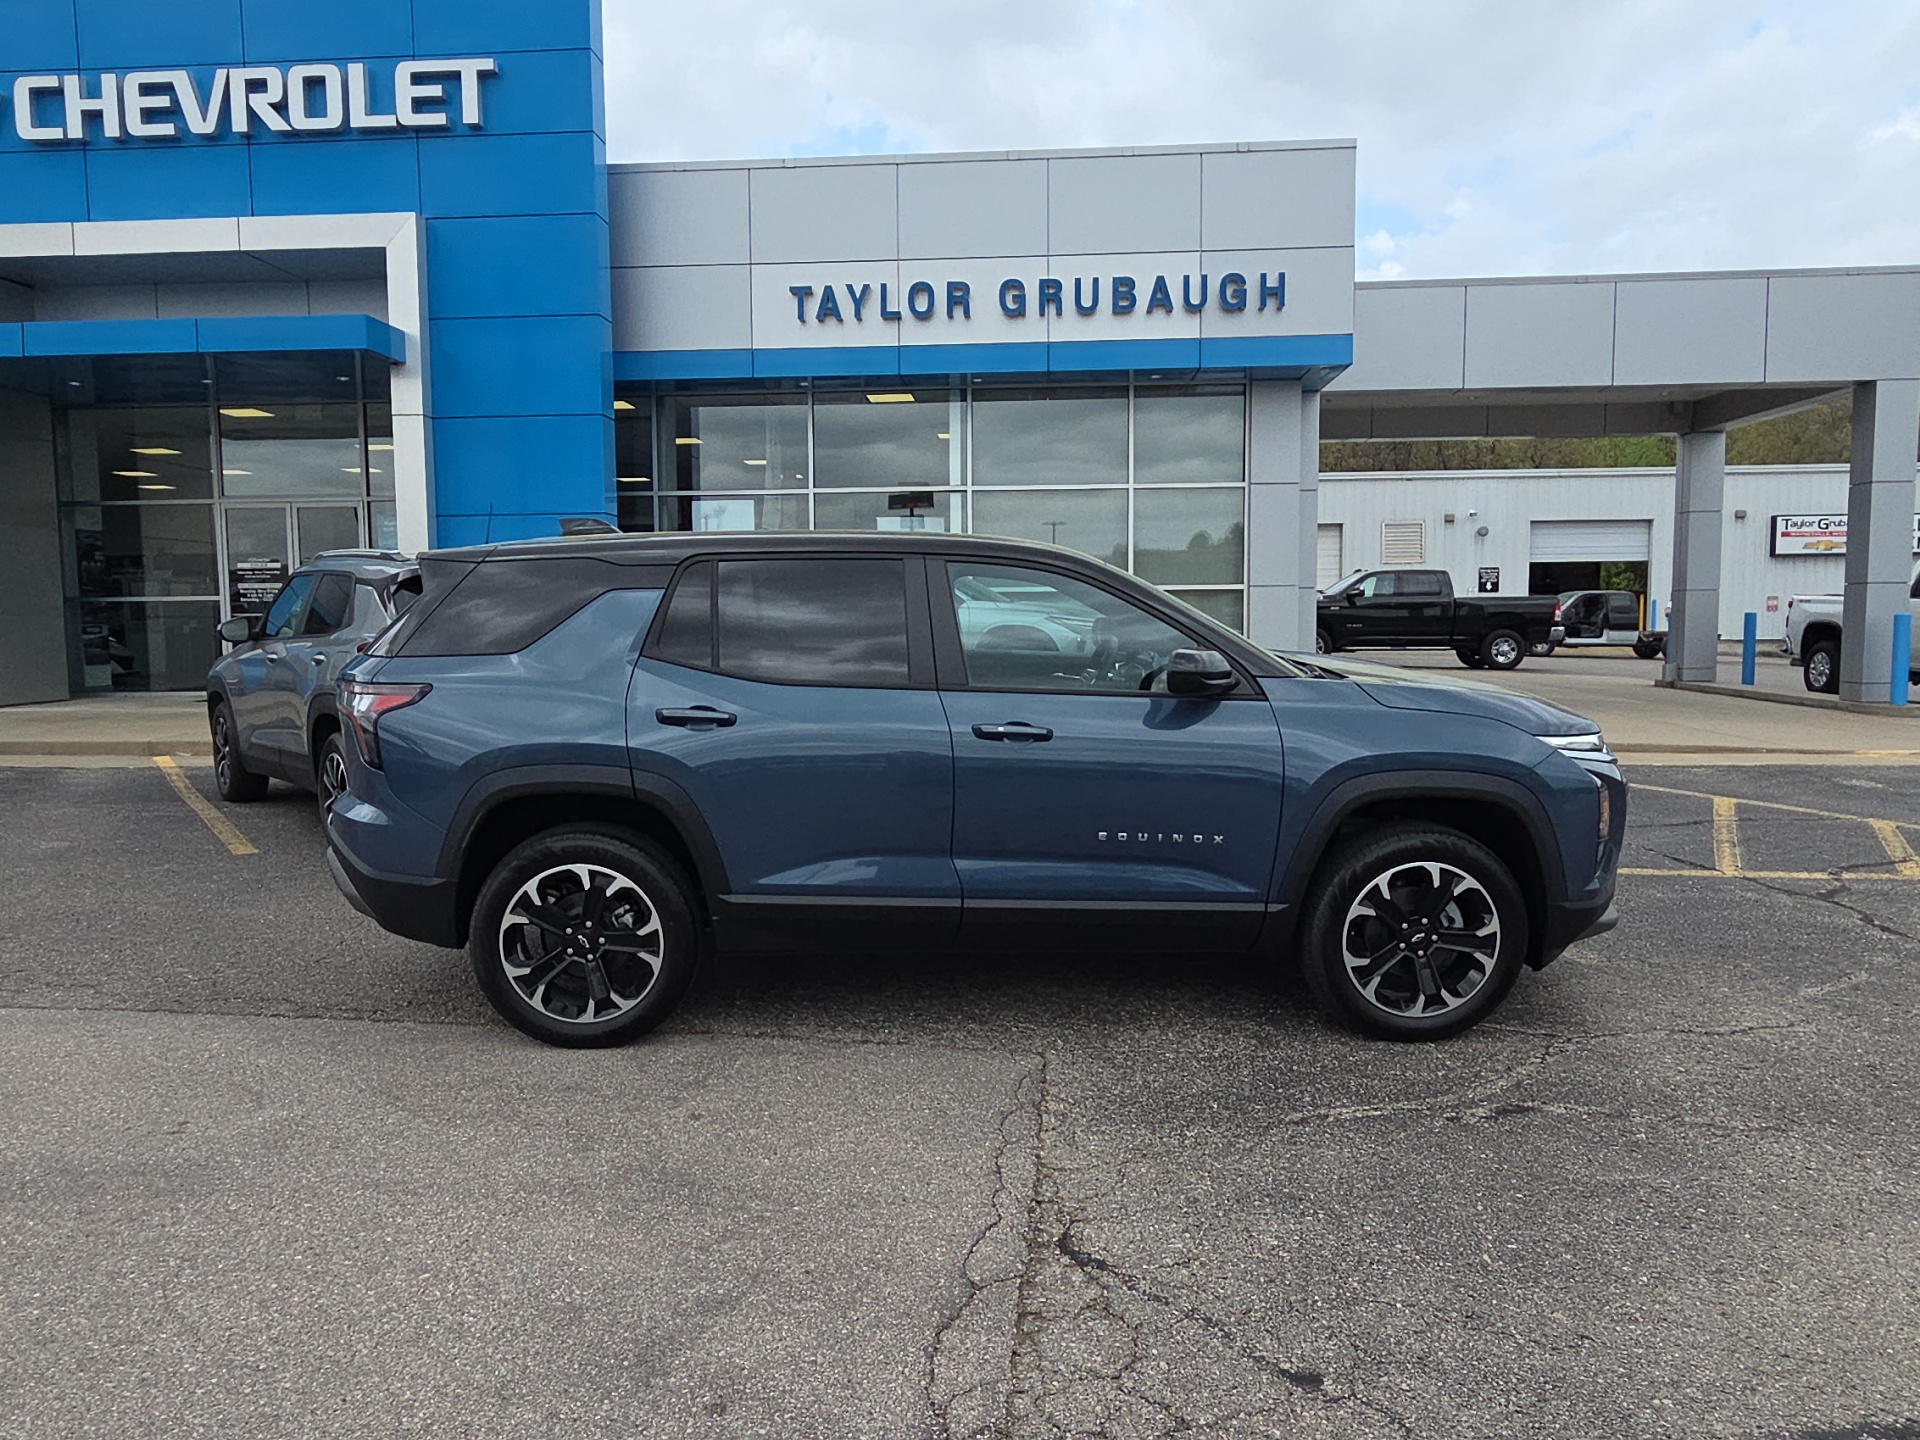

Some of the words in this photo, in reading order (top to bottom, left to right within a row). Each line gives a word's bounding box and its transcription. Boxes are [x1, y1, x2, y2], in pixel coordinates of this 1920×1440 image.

[13, 58, 497, 140] CHEVROLET
[789, 281, 971, 322] TAYLOR
[999, 271, 1287, 318] GRUBAUGH
[1781, 518, 1816, 530] Taylor
[1818, 518, 1847, 530] Grub
[1098, 831, 1223, 844] EQUINOX
